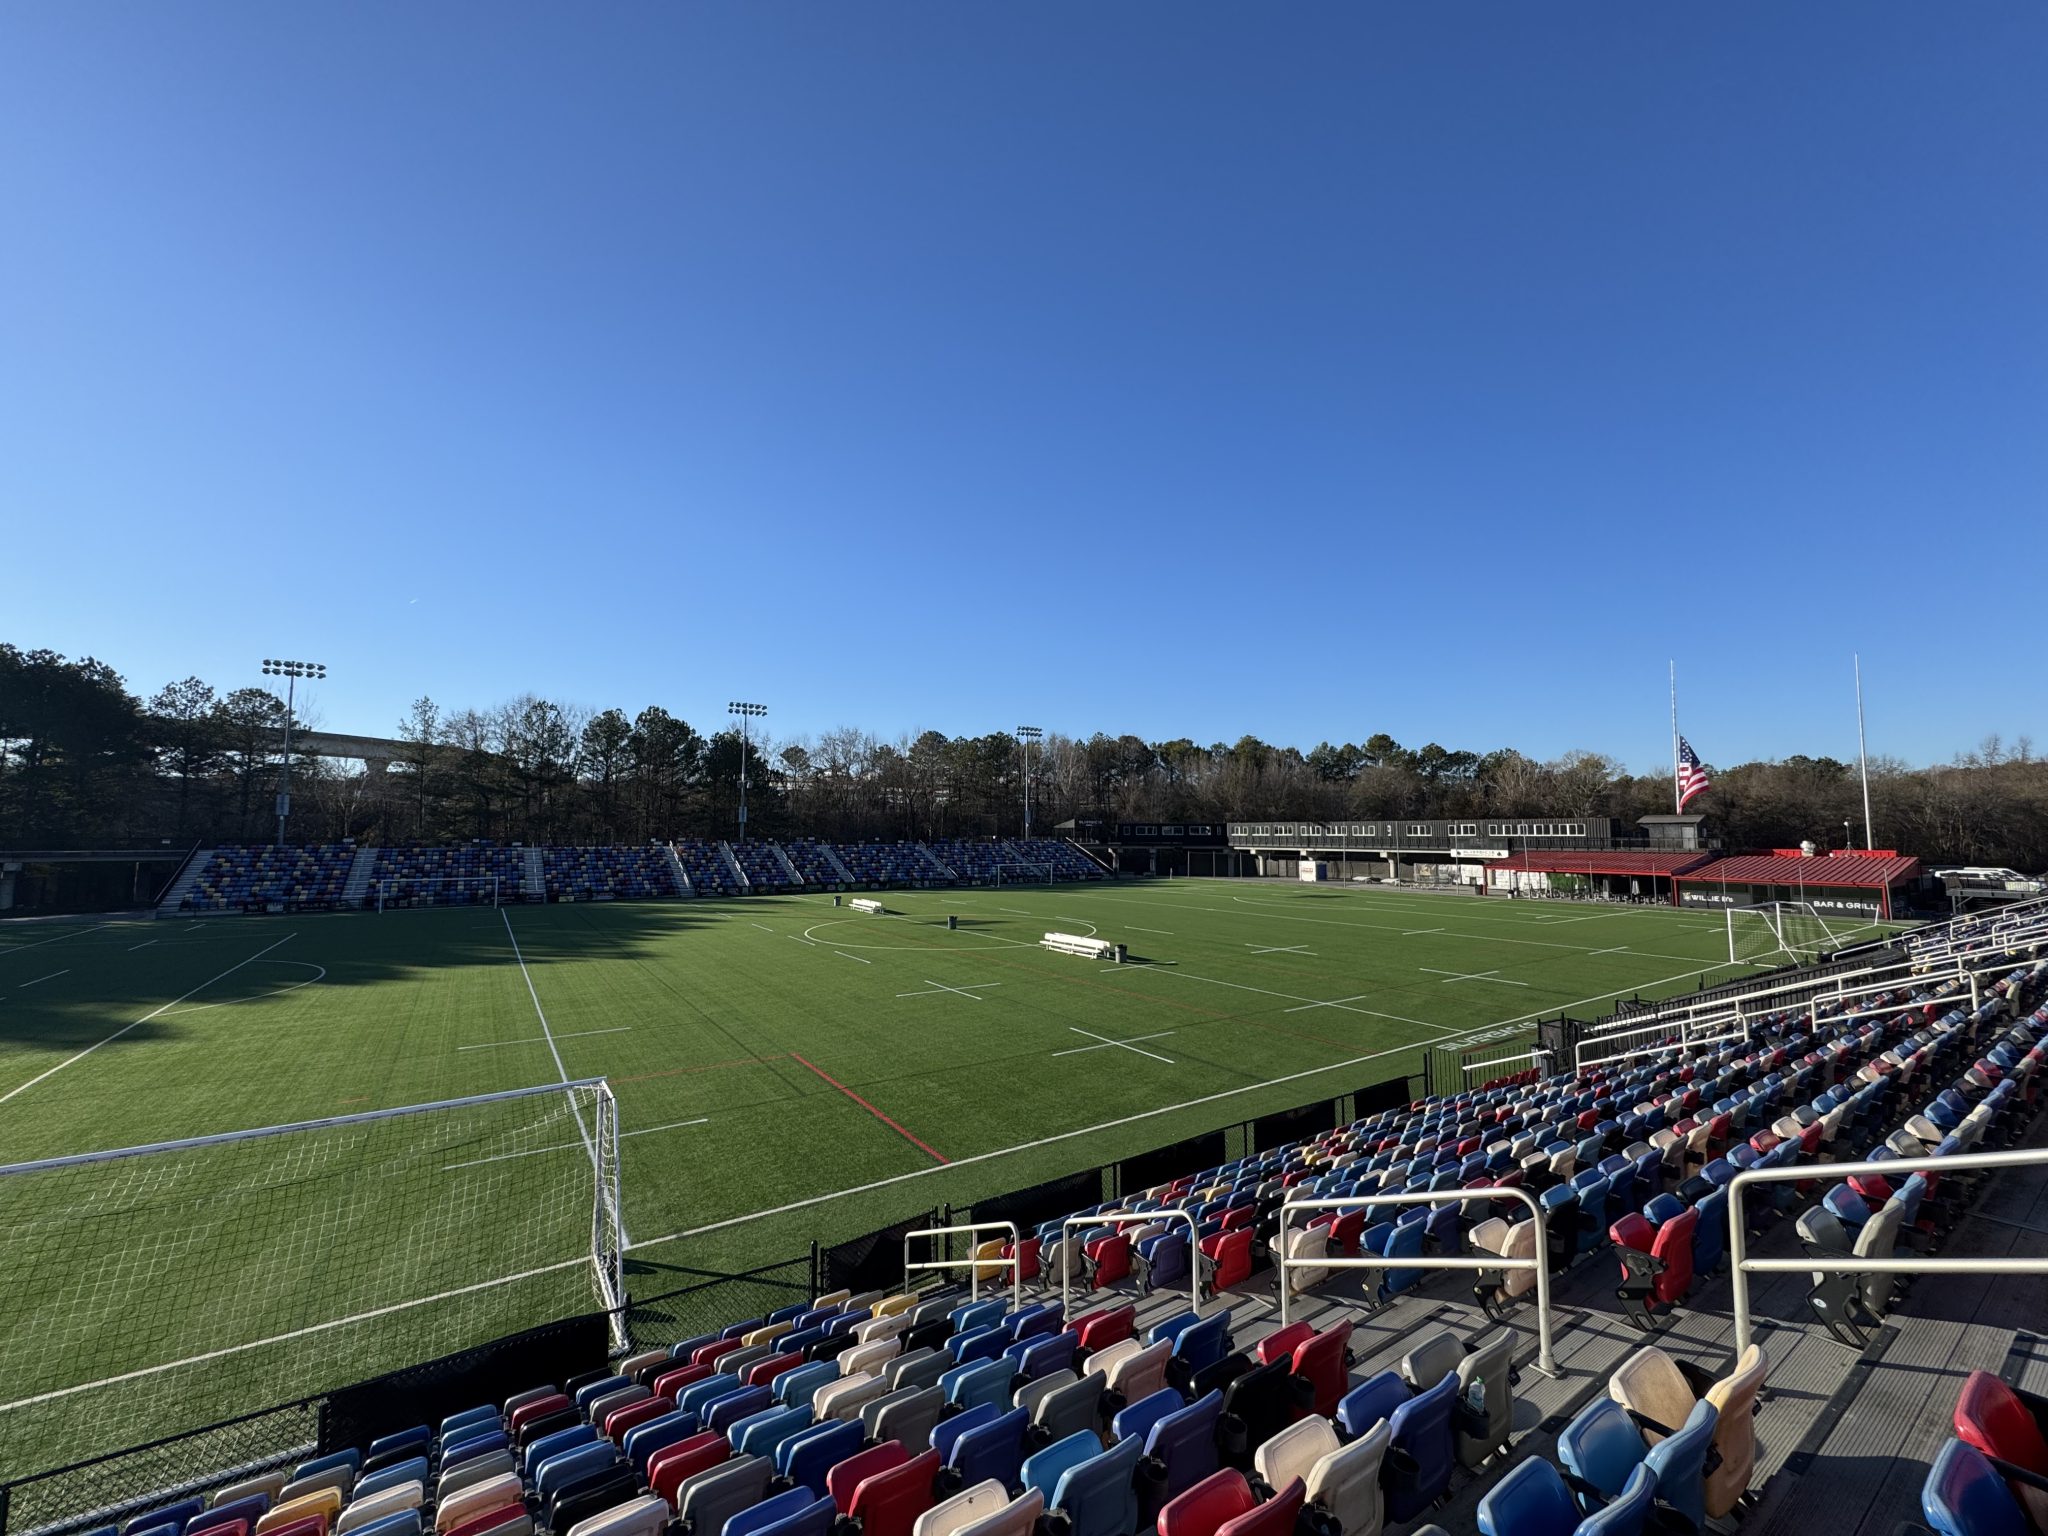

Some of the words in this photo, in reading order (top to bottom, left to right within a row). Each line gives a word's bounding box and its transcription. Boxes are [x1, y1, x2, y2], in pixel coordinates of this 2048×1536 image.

[1691, 894, 1720, 902] WILLIE
[1813, 900, 1834, 908] BAR
[1836, 901, 1844, 909] &
[1845, 902, 1877, 910] GRILL
